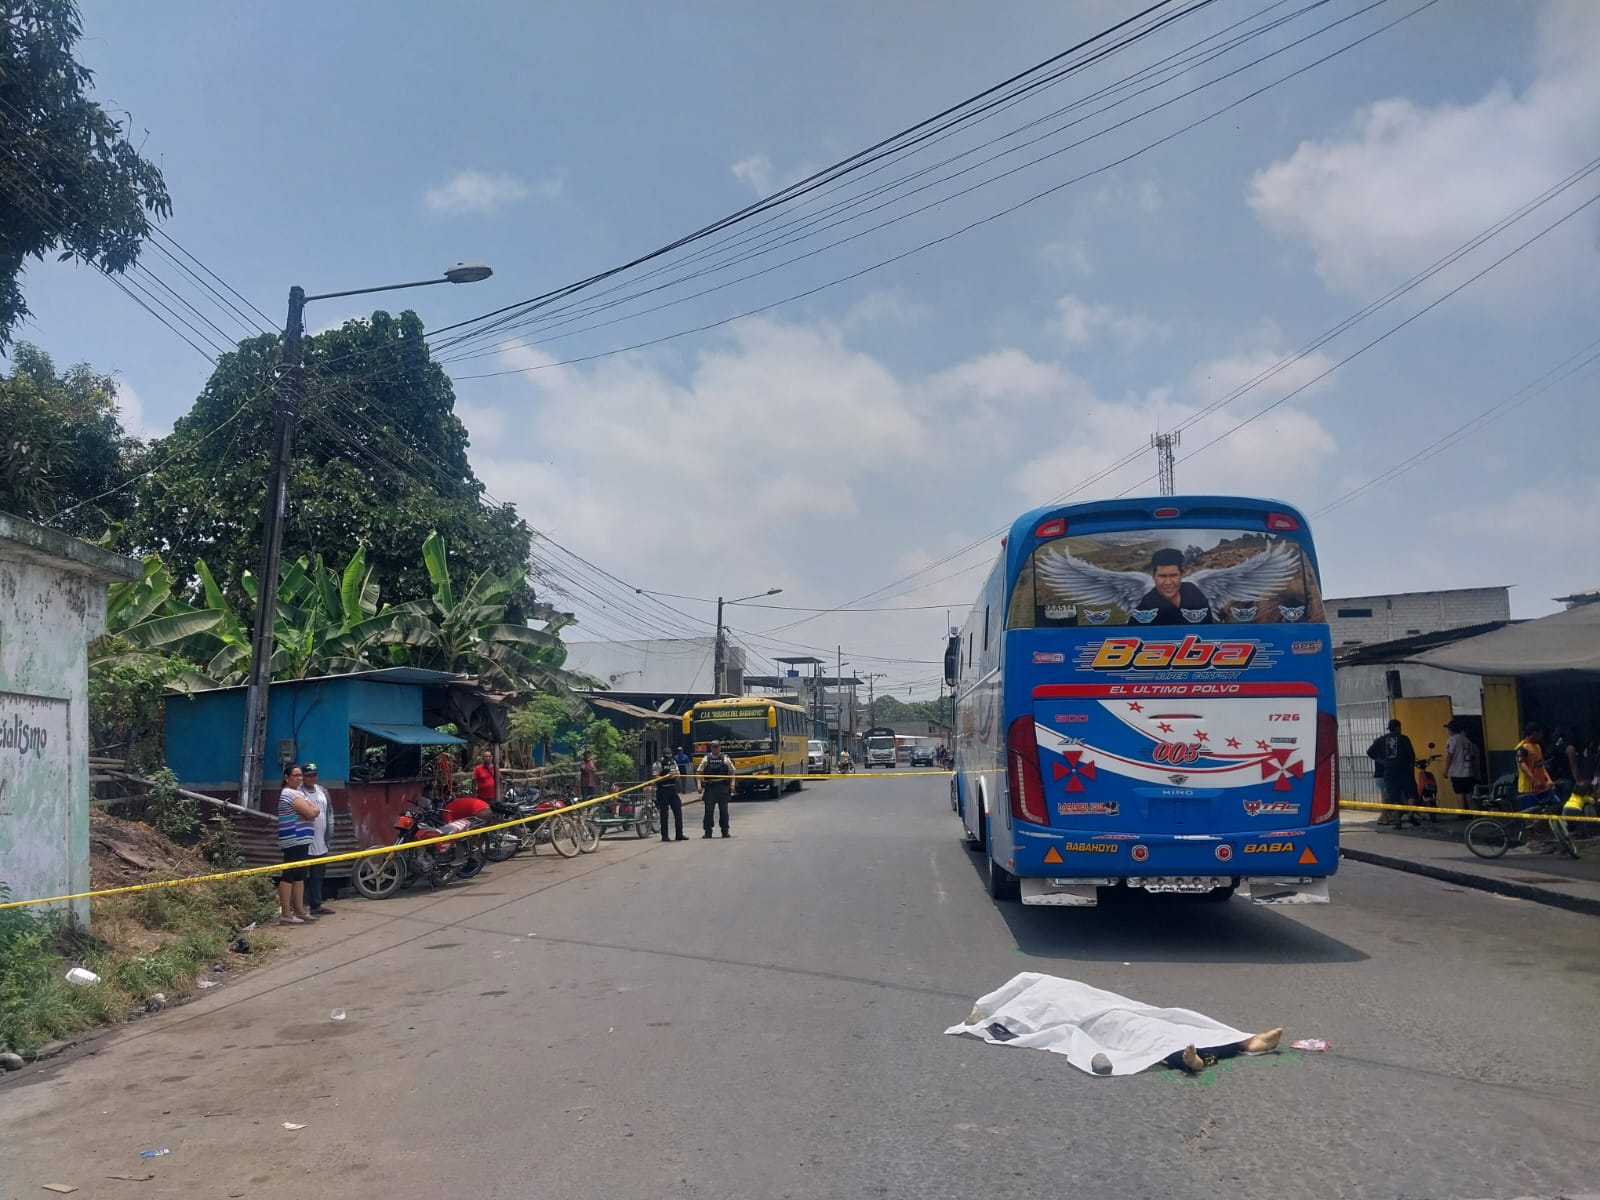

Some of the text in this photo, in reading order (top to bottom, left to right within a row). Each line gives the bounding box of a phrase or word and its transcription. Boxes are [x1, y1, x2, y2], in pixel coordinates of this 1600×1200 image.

[1091, 634, 1257, 671] Baba
[1109, 684, 1240, 694] EL ULTIMO POLVO
[1268, 713, 1300, 721] 1726
[1153, 742, 1201, 764] 005
[1065, 842, 1118, 853] BABAHOYO
[1243, 842, 1294, 853] BABA
